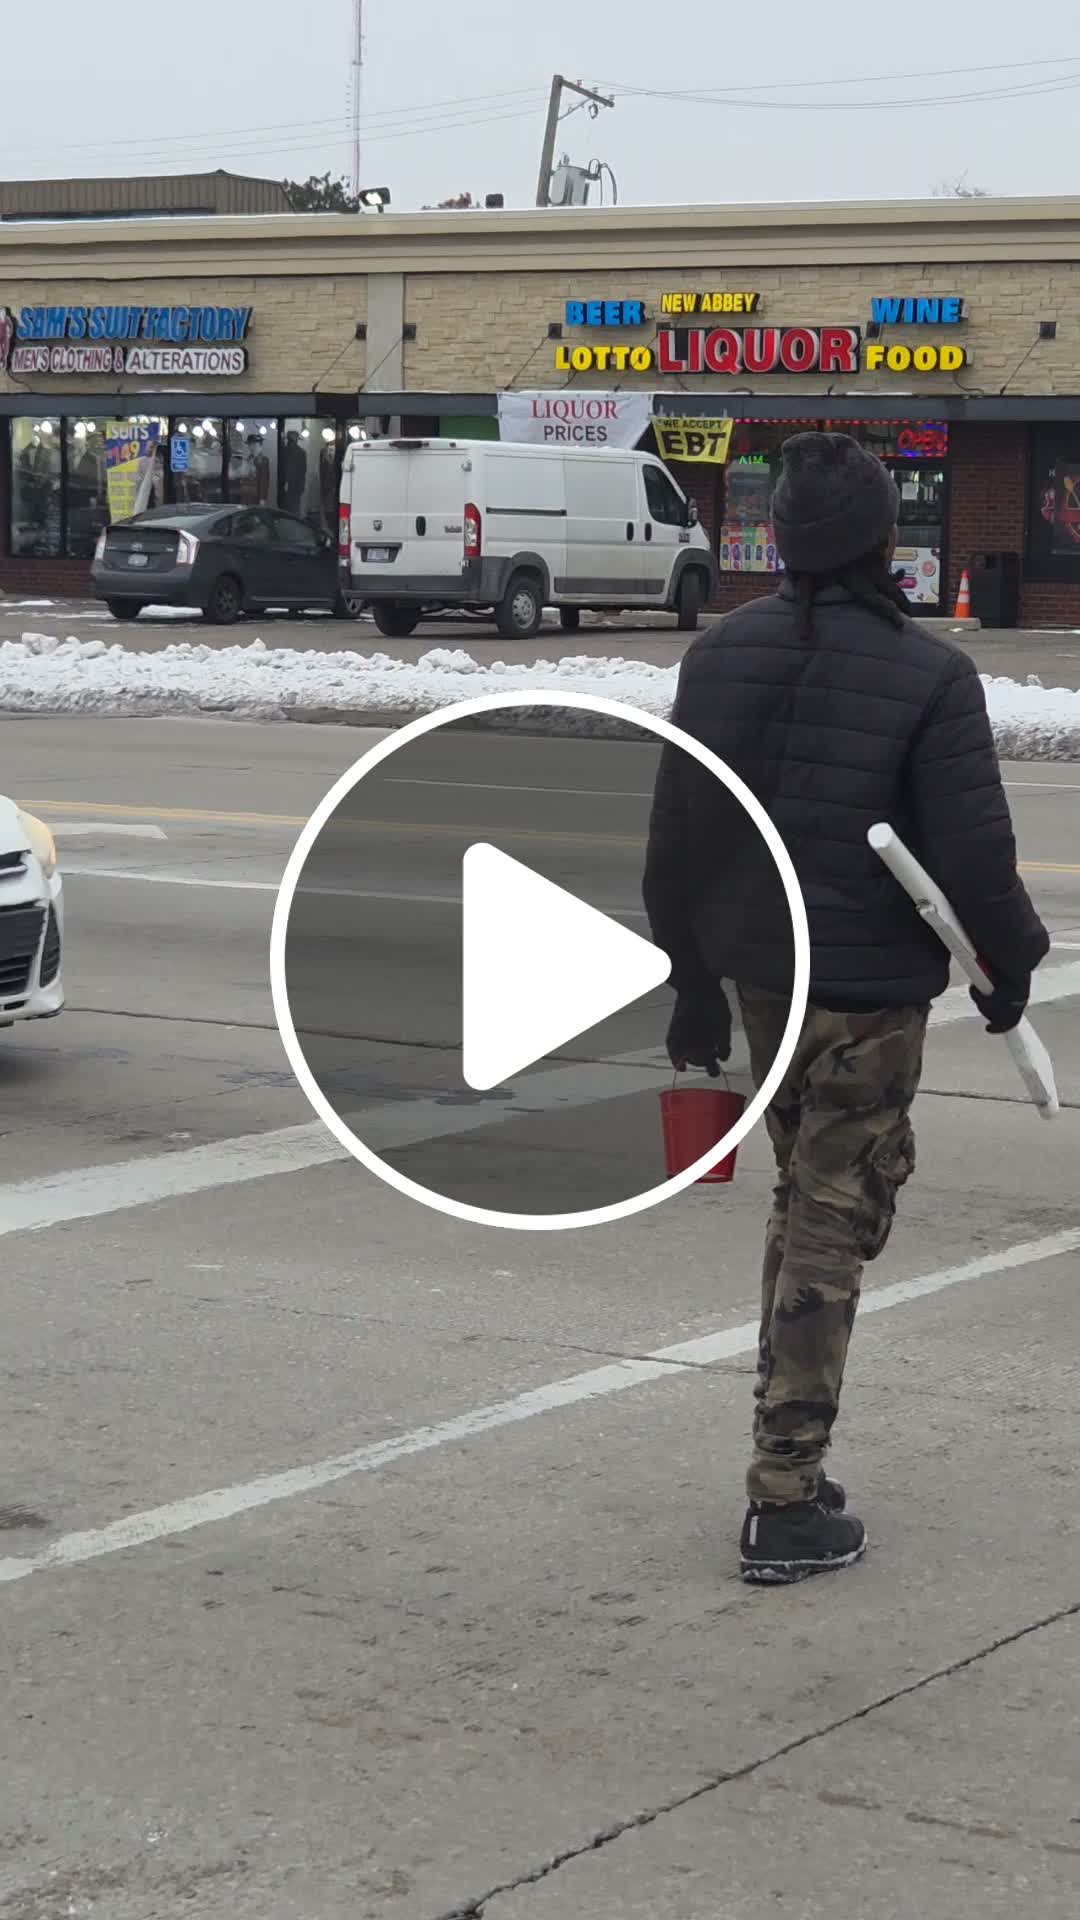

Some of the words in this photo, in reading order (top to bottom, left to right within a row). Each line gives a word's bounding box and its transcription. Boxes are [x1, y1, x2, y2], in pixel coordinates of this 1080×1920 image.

[566, 300, 643, 326] BEER
[661, 293, 697, 313] NEW
[701, 293, 756, 313] ABBEY
[871, 297, 962, 324] WINE
[16, 306, 88, 339] SAM'S
[88, 306, 145, 339] SUIT
[143, 305, 250, 341] FACTORY
[14, 347, 50, 371] MEN'S
[51, 347, 112, 372] CLOTHING
[113, 347, 124, 372] &
[127, 350, 243, 372] ALTERATIONS
[556, 345, 652, 371] LOTTO
[657, 328, 858, 375] LIQUOR
[866, 345, 964, 371] FOOD
[530, 399, 618, 424] LIQUOR
[663, 419, 680, 428] WE
[682, 419, 721, 429] ACCEPT
[543, 425, 608, 441] PRICES
[661, 430, 727, 457] EBT
